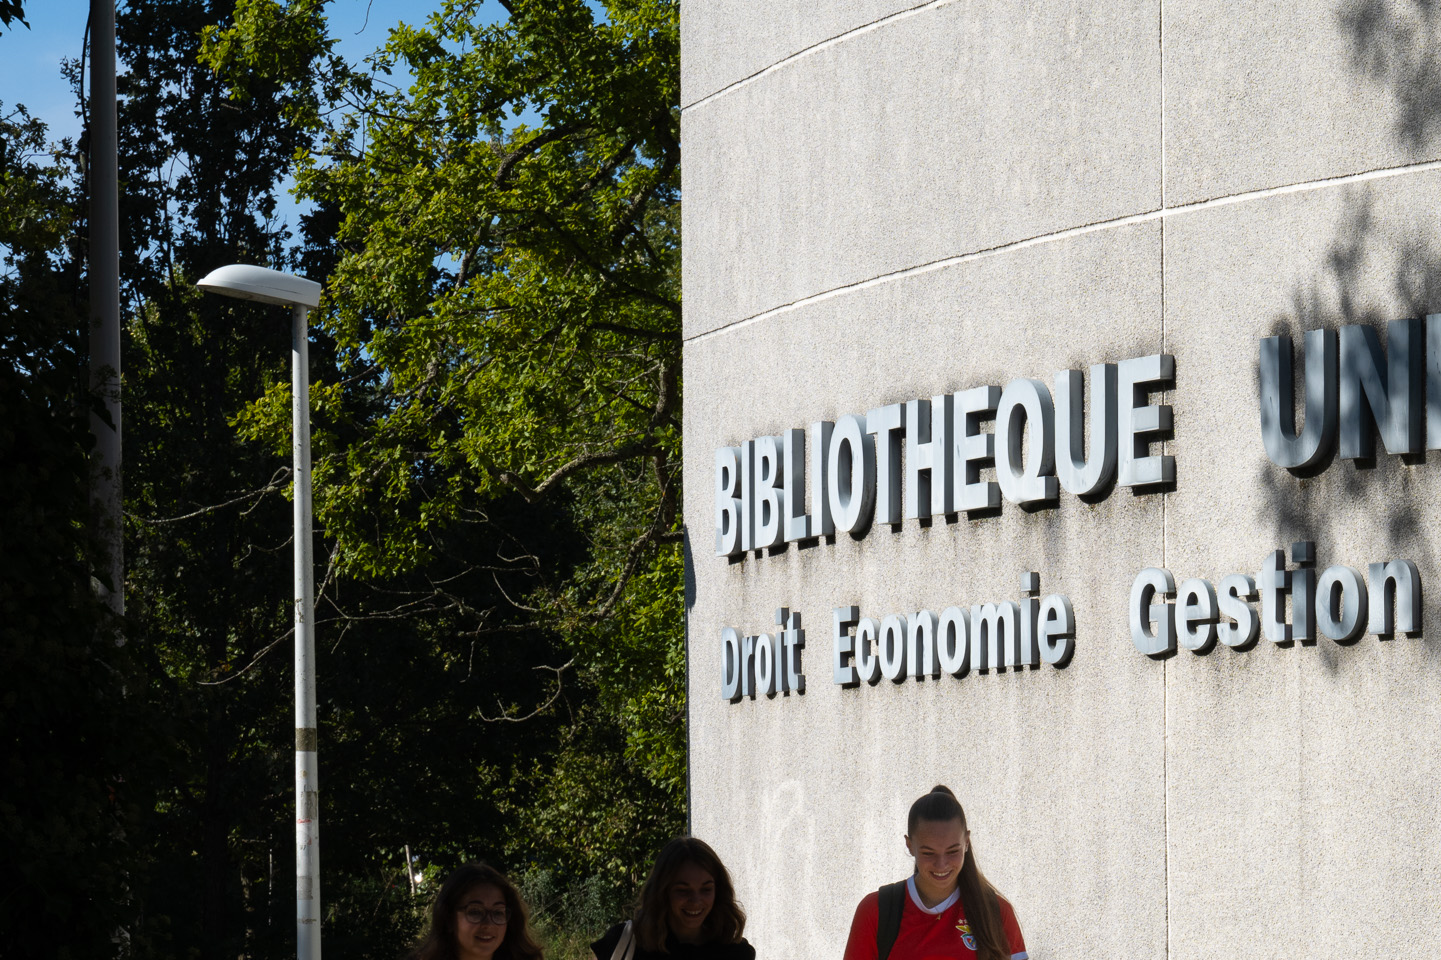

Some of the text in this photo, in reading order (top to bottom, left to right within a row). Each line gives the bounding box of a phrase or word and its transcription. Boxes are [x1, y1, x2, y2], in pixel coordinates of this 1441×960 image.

[715, 353, 1176, 558] BIBLIOTHEQUE
[721, 541, 1423, 699] Droit Economie Gestion
